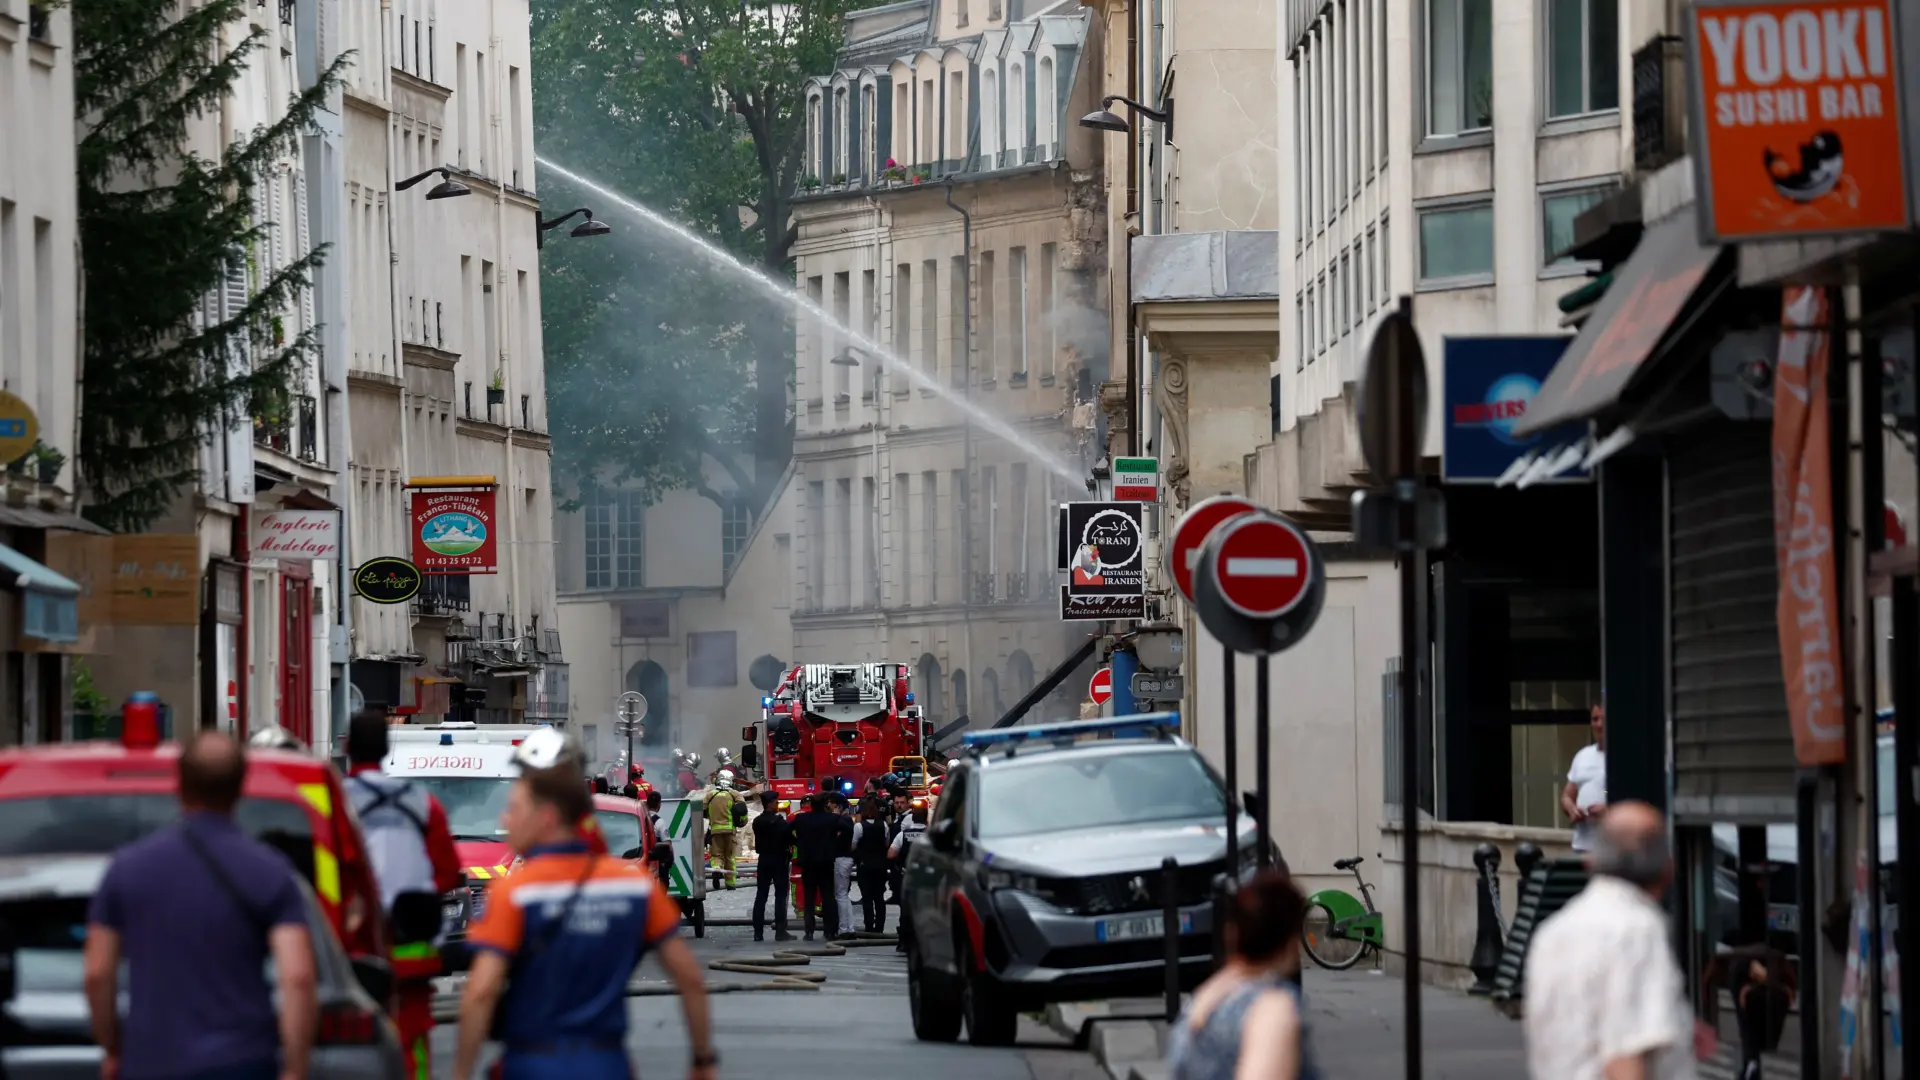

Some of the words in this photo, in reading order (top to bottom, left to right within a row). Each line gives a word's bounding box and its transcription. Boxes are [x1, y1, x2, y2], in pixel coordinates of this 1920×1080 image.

[1702, 7, 1887, 87] YOOKI
[1715, 88, 1808, 128] SUSHI
[1818, 83, 1883, 121] BAR
[1122, 474, 1149, 484] Iranien
[427, 494, 480, 506] Restaurant
[417, 502, 489, 523] Franco-Tibétain
[260, 514, 331, 534] Onglerie
[255, 536, 336, 557] Modelage
[1092, 536, 1131, 546] TORANJ
[449, 557, 459, 565] 25
[361, 572, 381, 584] La
[1065, 607, 1100, 615] Traiteur
[1101, 606, 1141, 616] Asiatique
